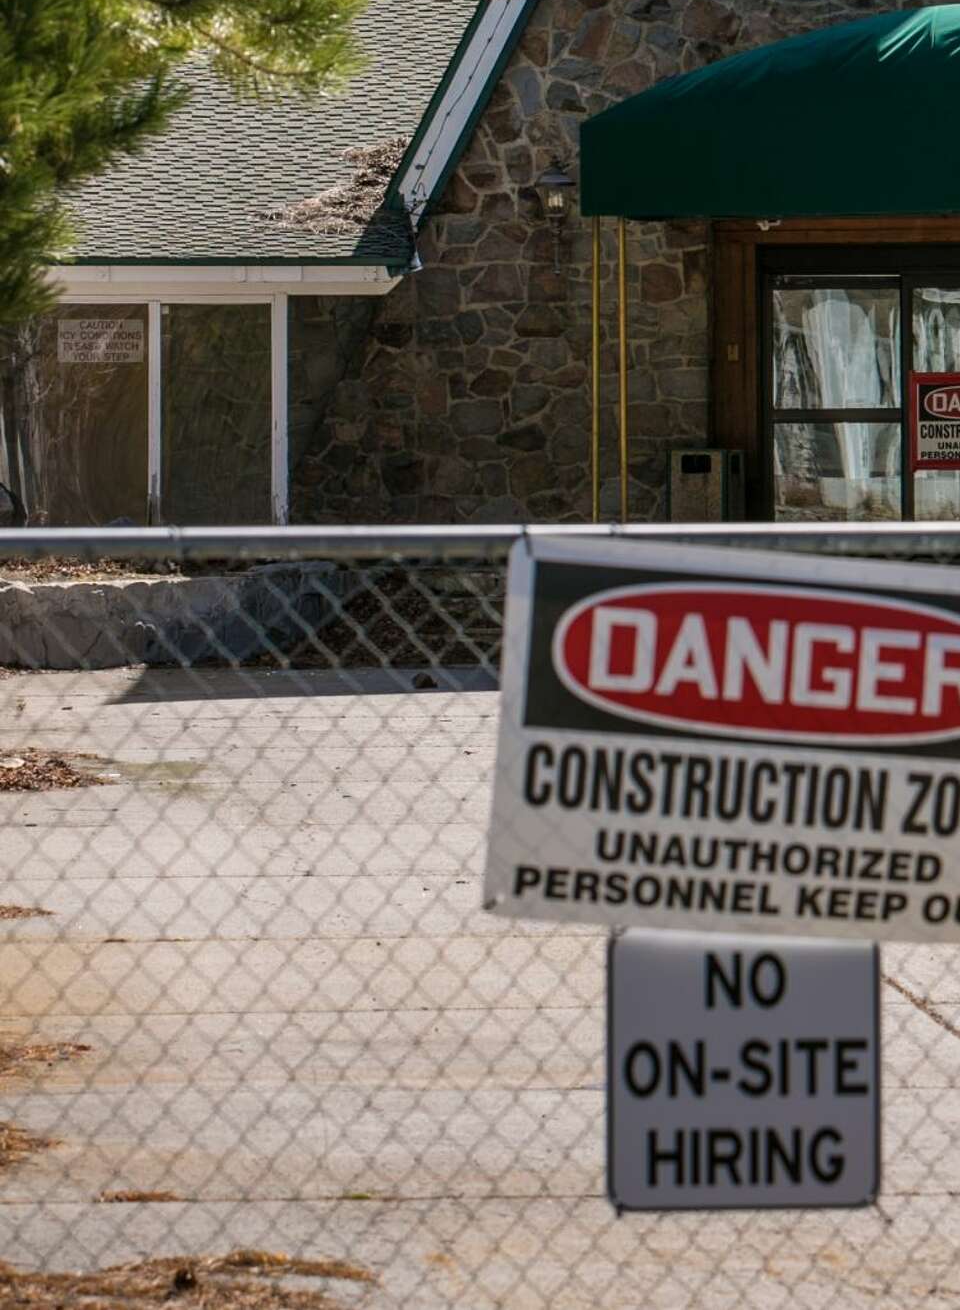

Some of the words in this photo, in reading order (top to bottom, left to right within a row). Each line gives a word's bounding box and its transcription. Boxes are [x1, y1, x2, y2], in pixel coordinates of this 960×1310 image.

[80, 331, 142, 340] CONDTIONS
[523, 742, 889, 832] CONSTRUCTION
[596, 829, 943, 883] UNAUTHORIZED
[513, 864, 781, 916] PERSONNEL
[795, 886, 908, 921] KEEP
[705, 950, 787, 1010] NO
[622, 1037, 869, 1099] ON-SITE
[647, 1127, 846, 1188] HIRING
